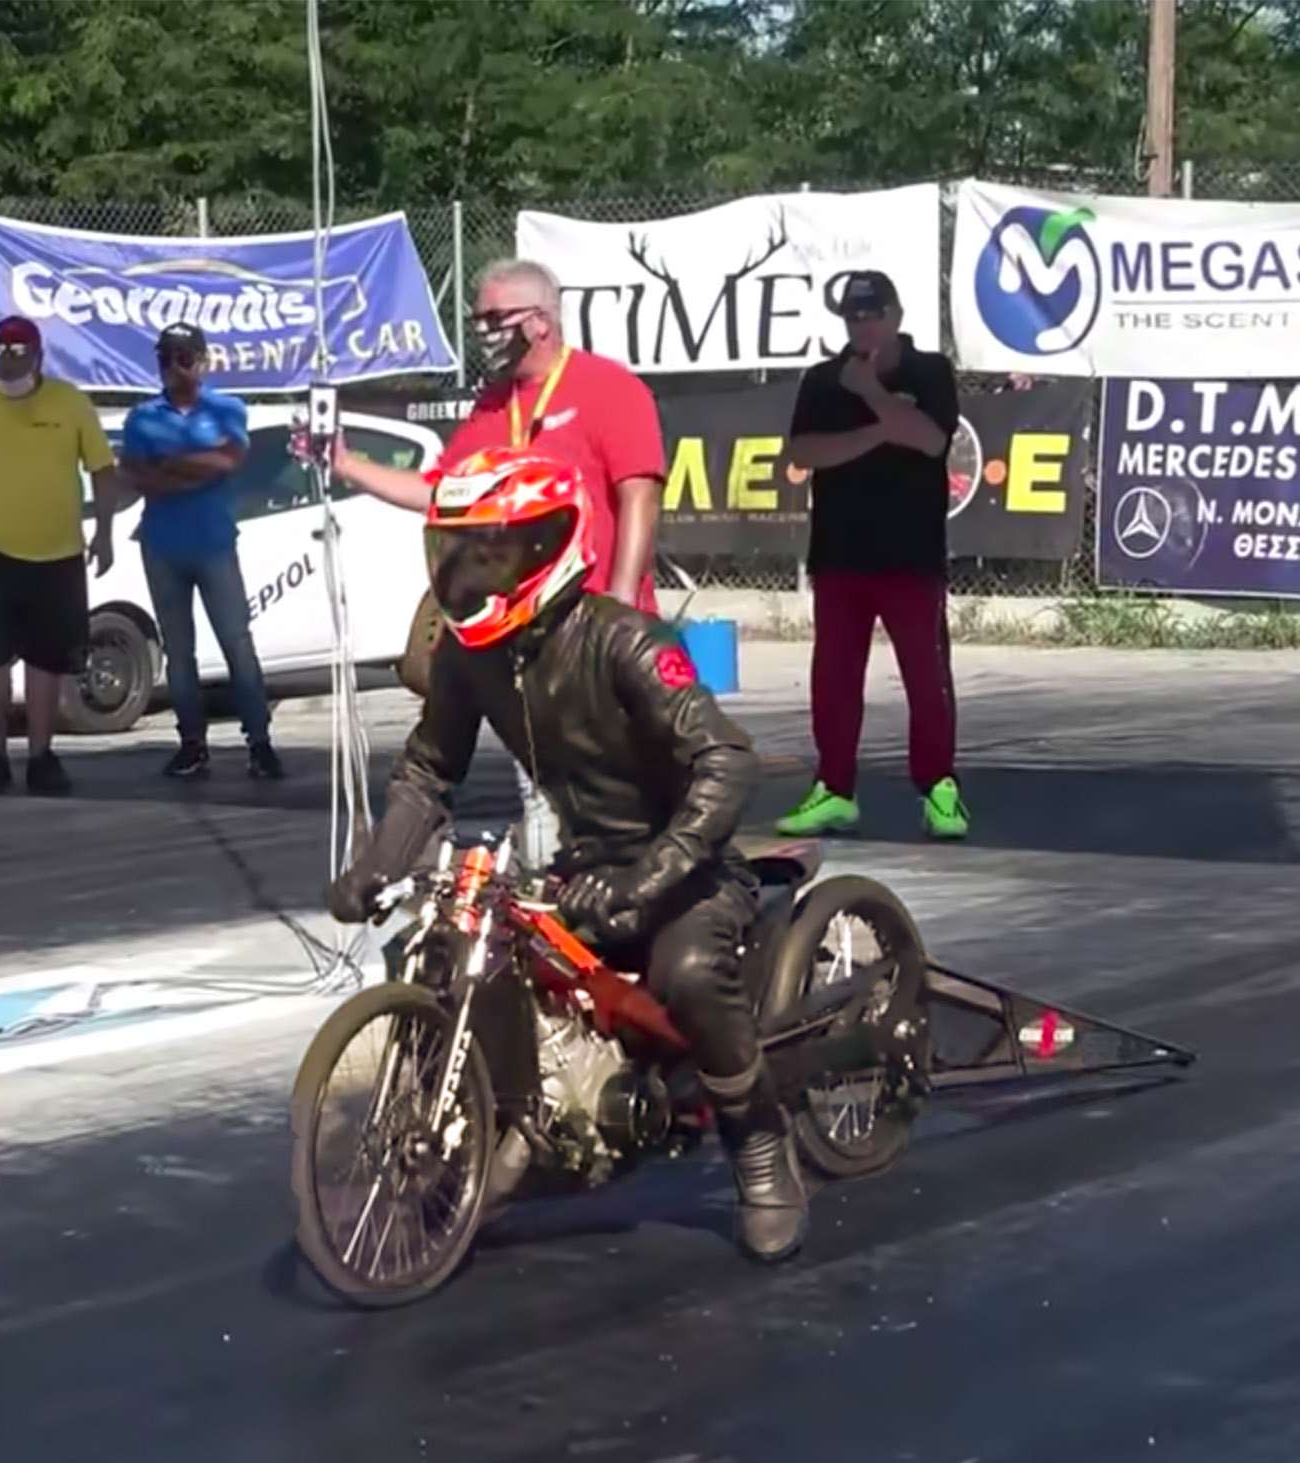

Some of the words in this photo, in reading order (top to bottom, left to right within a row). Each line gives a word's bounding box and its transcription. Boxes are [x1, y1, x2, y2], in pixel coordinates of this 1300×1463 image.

[1111, 241, 1300, 293] MEGA
[12, 261, 315, 335] Georgiadis
[1114, 311, 1172, 329] THE
[1182, 312, 1289, 329] SCENT
[206, 336, 306, 373] RENT
[347, 319, 428, 359] CAR
[1117, 441, 1299, 480] MERCEDES
